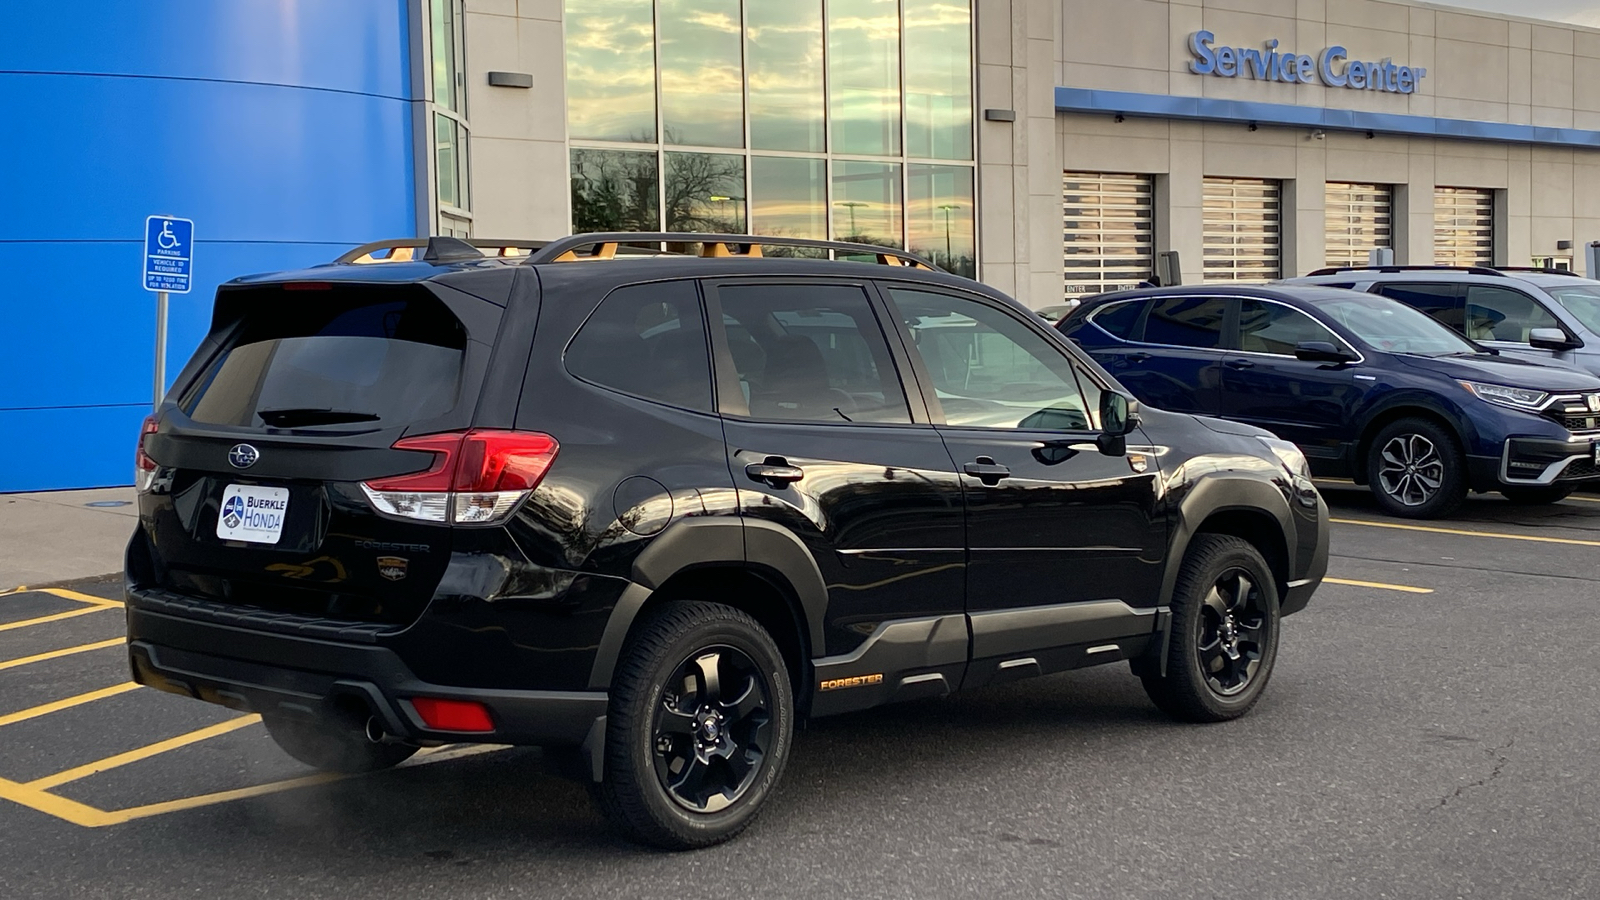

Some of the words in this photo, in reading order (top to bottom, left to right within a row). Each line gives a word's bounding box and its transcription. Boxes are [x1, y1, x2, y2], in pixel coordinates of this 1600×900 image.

[1188, 29, 1314, 84] Service
[1318, 45, 1427, 94] Center
[154, 265, 182, 273] REQUIRED
[1066, 285, 1086, 293] ENTER
[247, 496, 285, 510] BUERKLE
[243, 508, 280, 529] HONDA
[354, 540, 431, 553] FORESTER
[821, 673, 883, 690] FORESTER
